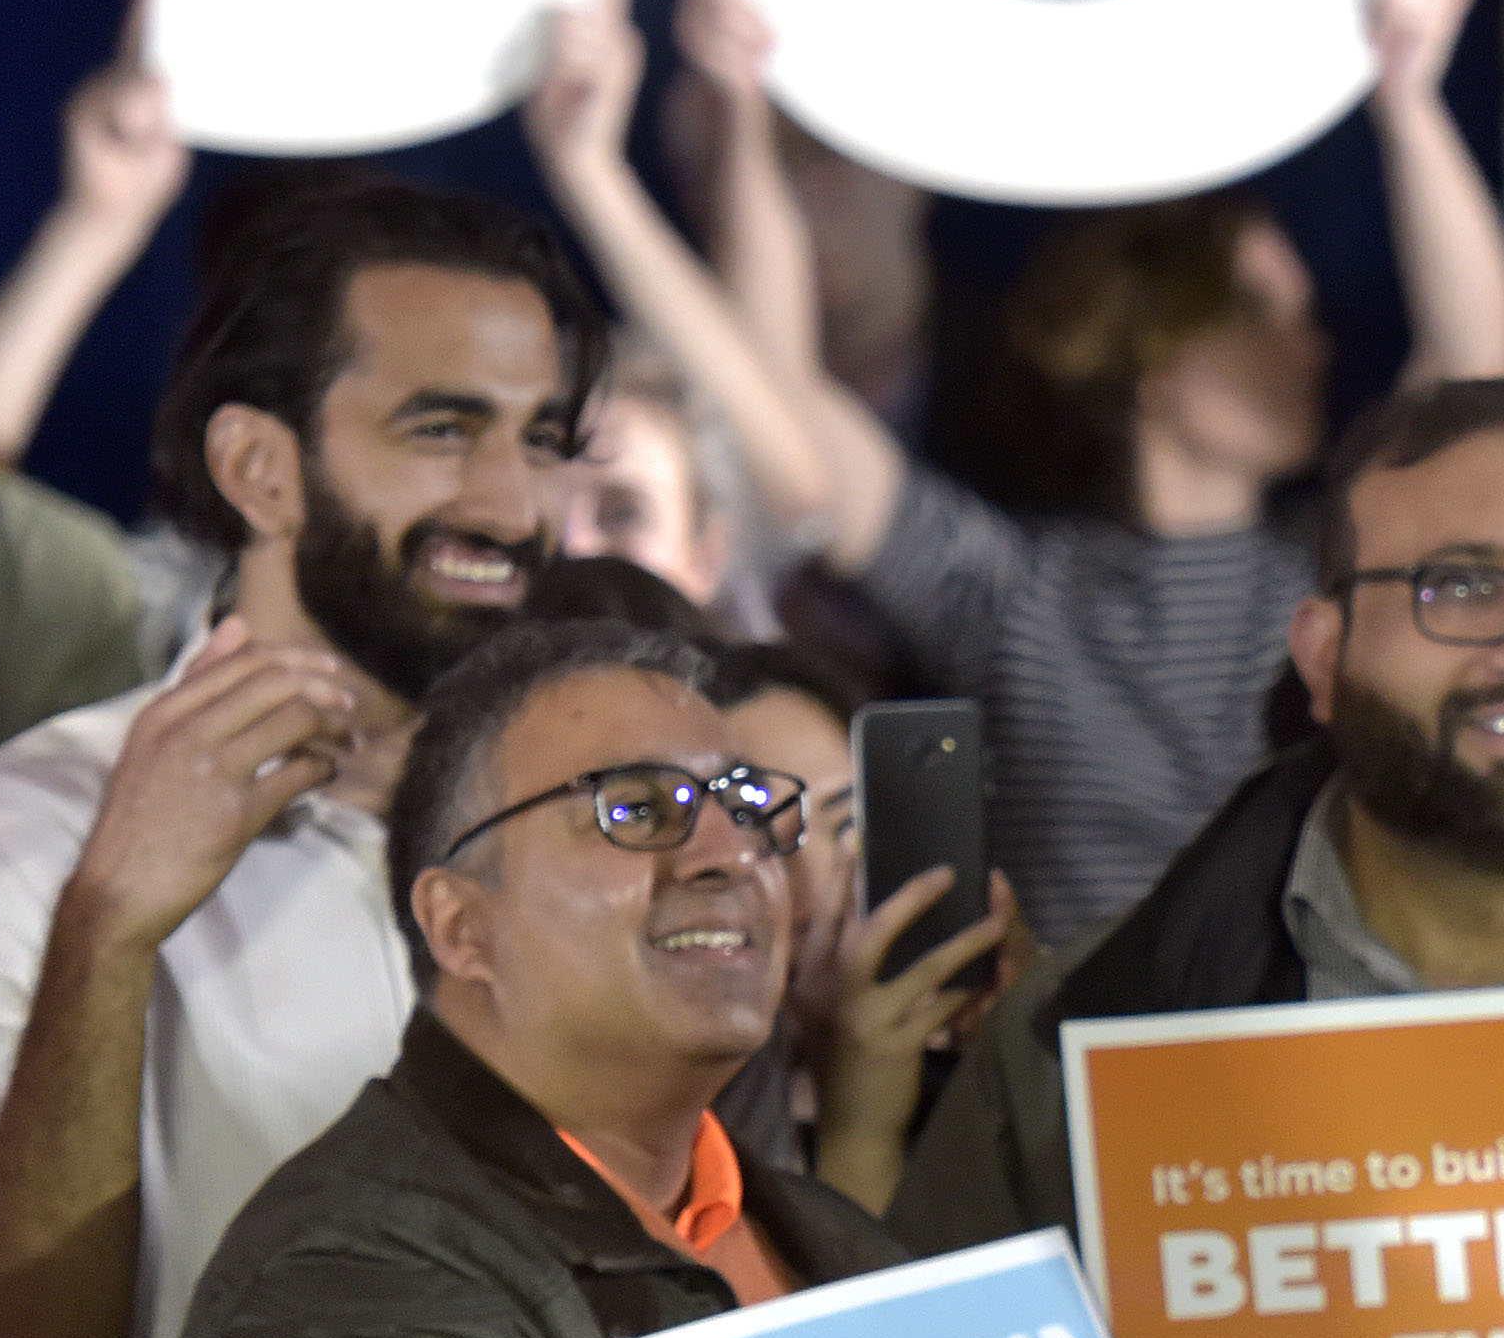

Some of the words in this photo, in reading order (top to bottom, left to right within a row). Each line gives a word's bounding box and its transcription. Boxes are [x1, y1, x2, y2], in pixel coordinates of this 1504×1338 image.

[1152, 1161, 1230, 1206] It's
[1239, 1154, 1357, 1200] time
[1364, 1149, 1422, 1191] to
